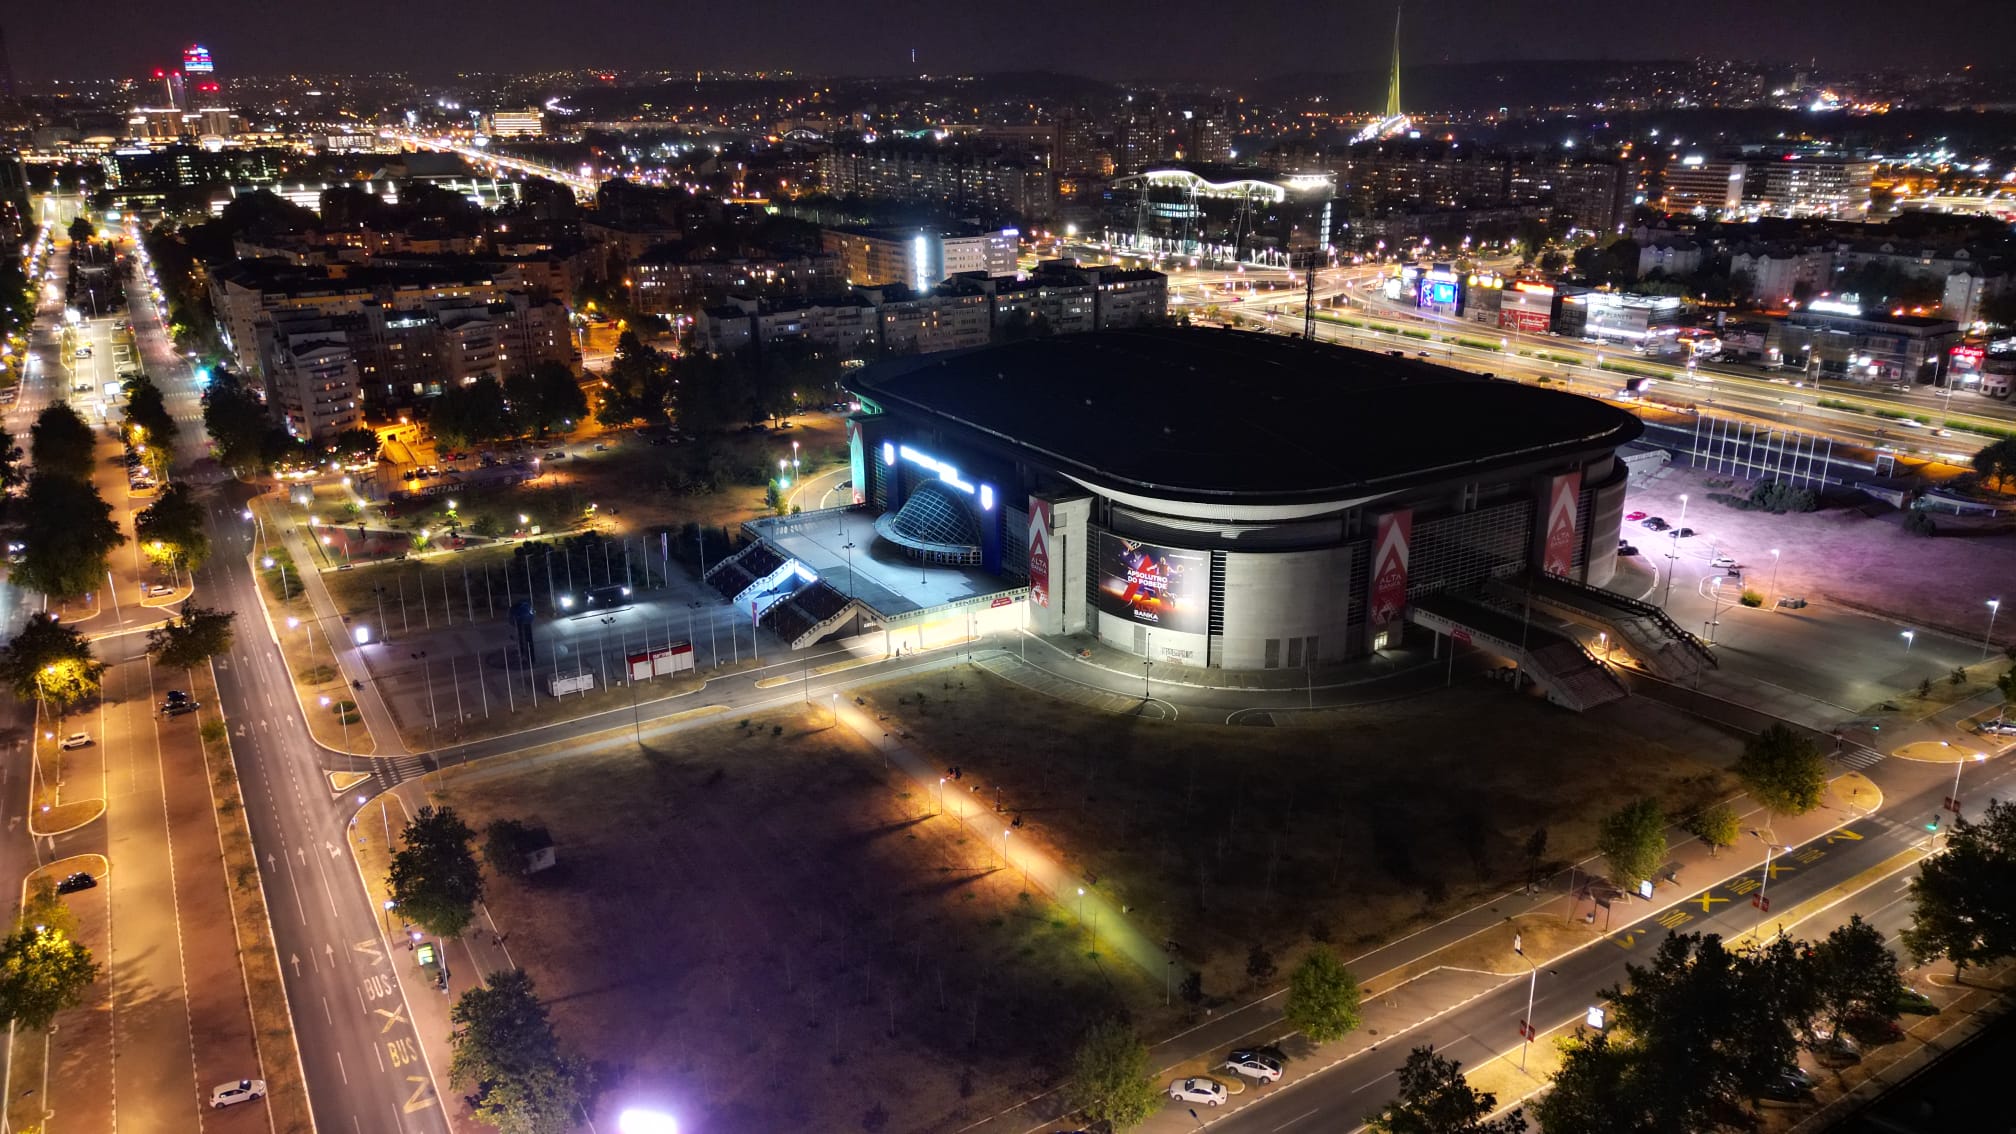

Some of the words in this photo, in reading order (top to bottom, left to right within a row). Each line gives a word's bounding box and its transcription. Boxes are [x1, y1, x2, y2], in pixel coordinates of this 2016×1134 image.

[1965, 349, 1983, 357] SPORT
[420, 482, 465, 497] MOZZART
[1127, 575, 1137, 583] DO
[1138, 578, 1168, 590] POBEDE
[1133, 609, 1159, 620] BANKA
[363, 973, 393, 1001] BUS
[387, 1036, 418, 1068] BUS
